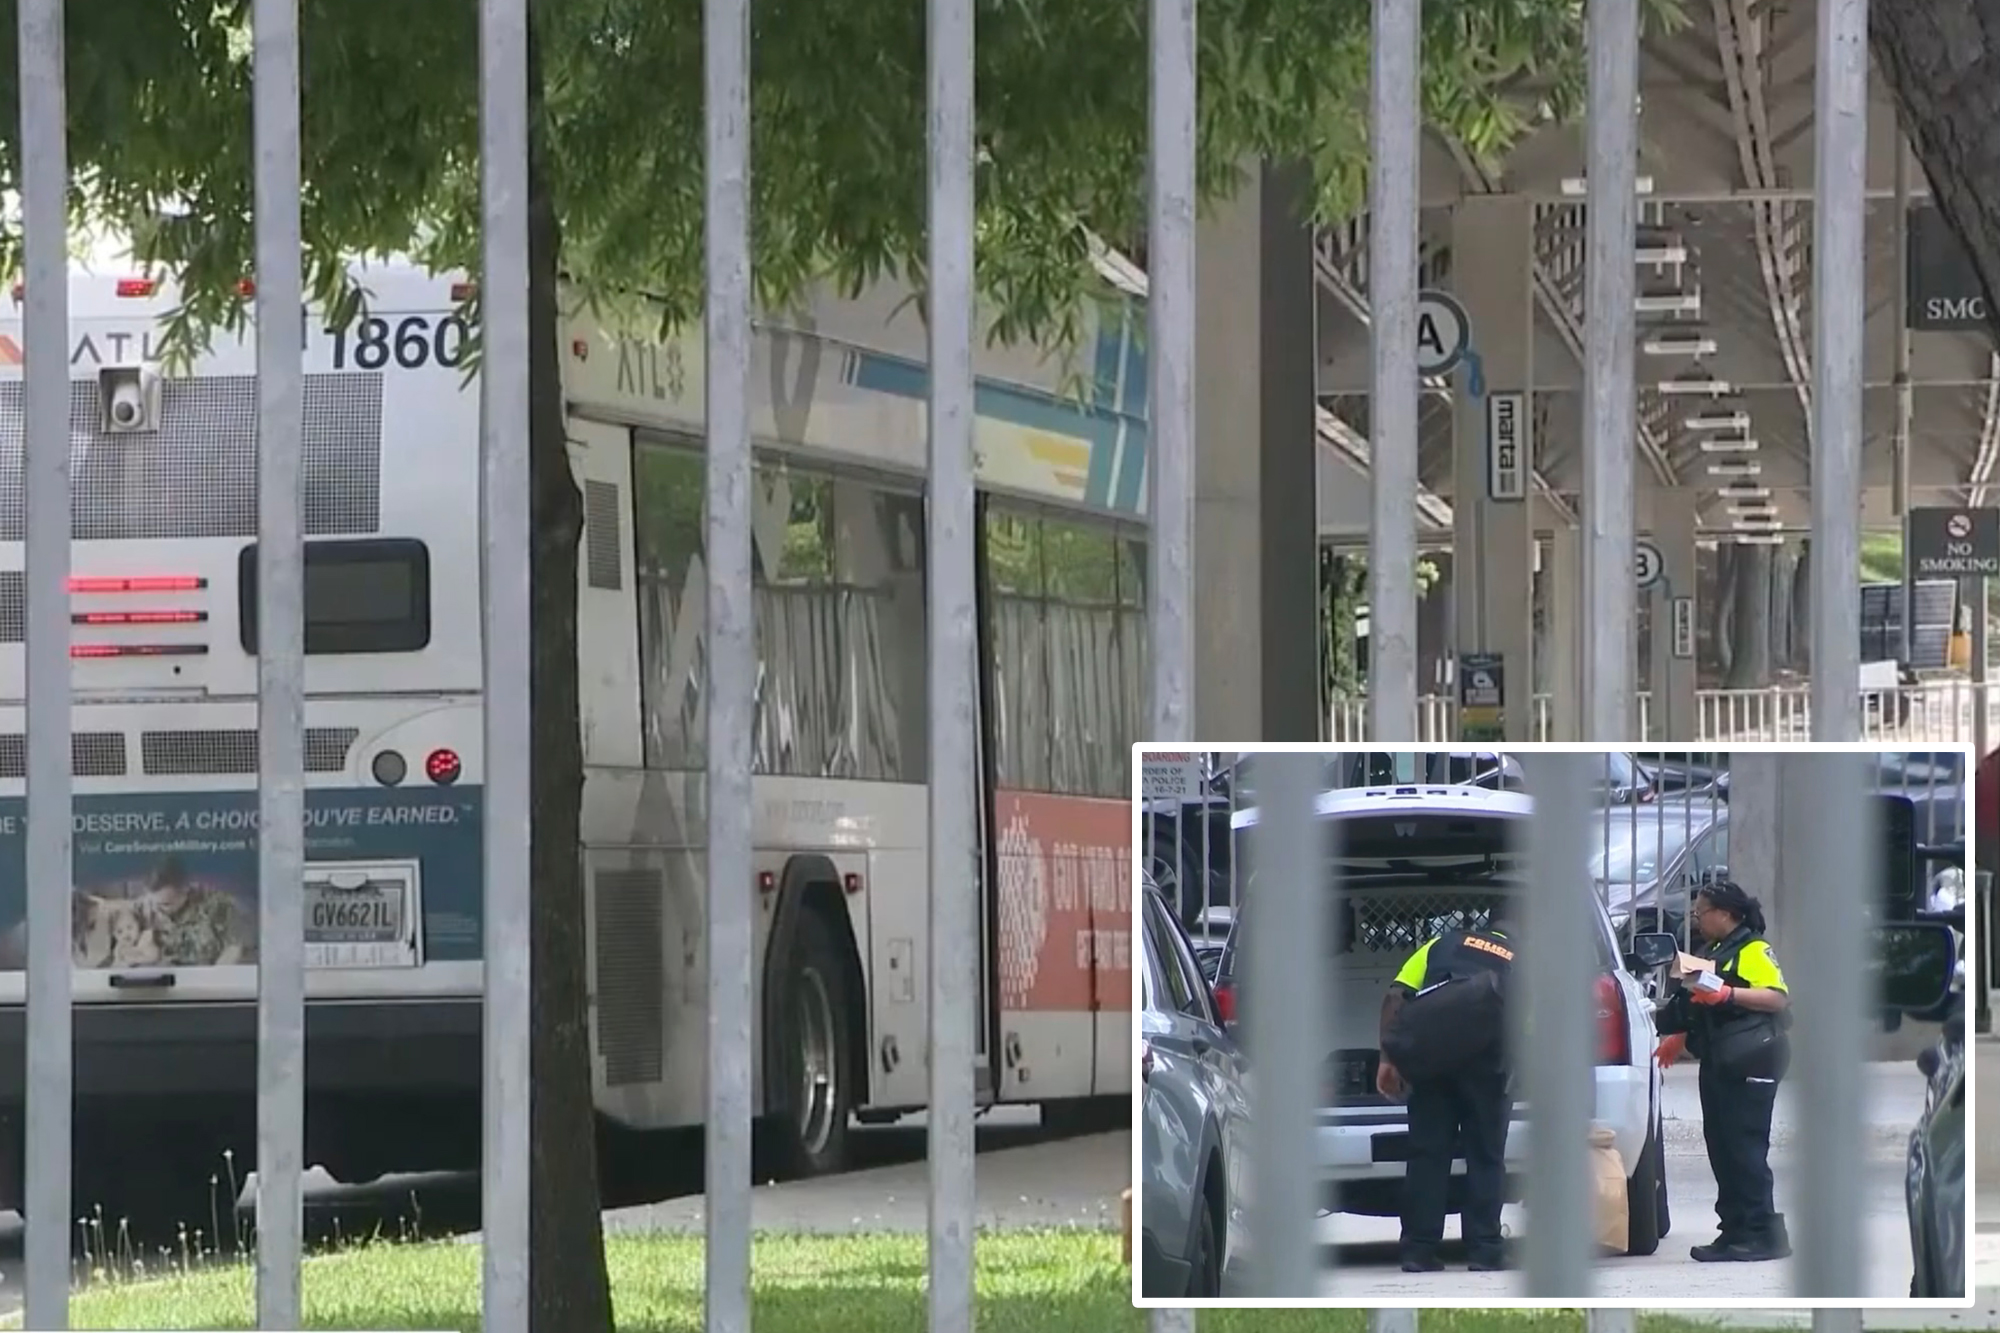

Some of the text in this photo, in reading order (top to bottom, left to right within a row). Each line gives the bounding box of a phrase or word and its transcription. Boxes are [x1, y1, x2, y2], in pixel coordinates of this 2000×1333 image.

[323, 315, 470, 370] 1860
[1418, 313, 1444, 355] A
[70, 331, 163, 365] ATL
[1498, 400, 1516, 470] marta
[1947, 542, 1972, 556] NO
[1919, 557, 1998, 572] SMOKING
[1142, 767, 1168, 775] RDER
[1151, 776, 1187, 785] POLICE
[72, 811, 171, 833] DESERVE,
[175, 811, 192, 830] A
[196, 809, 260, 829] CHOIC
[303, 807, 361, 828] OU'VE
[313, 901, 394, 928] GV6621L
